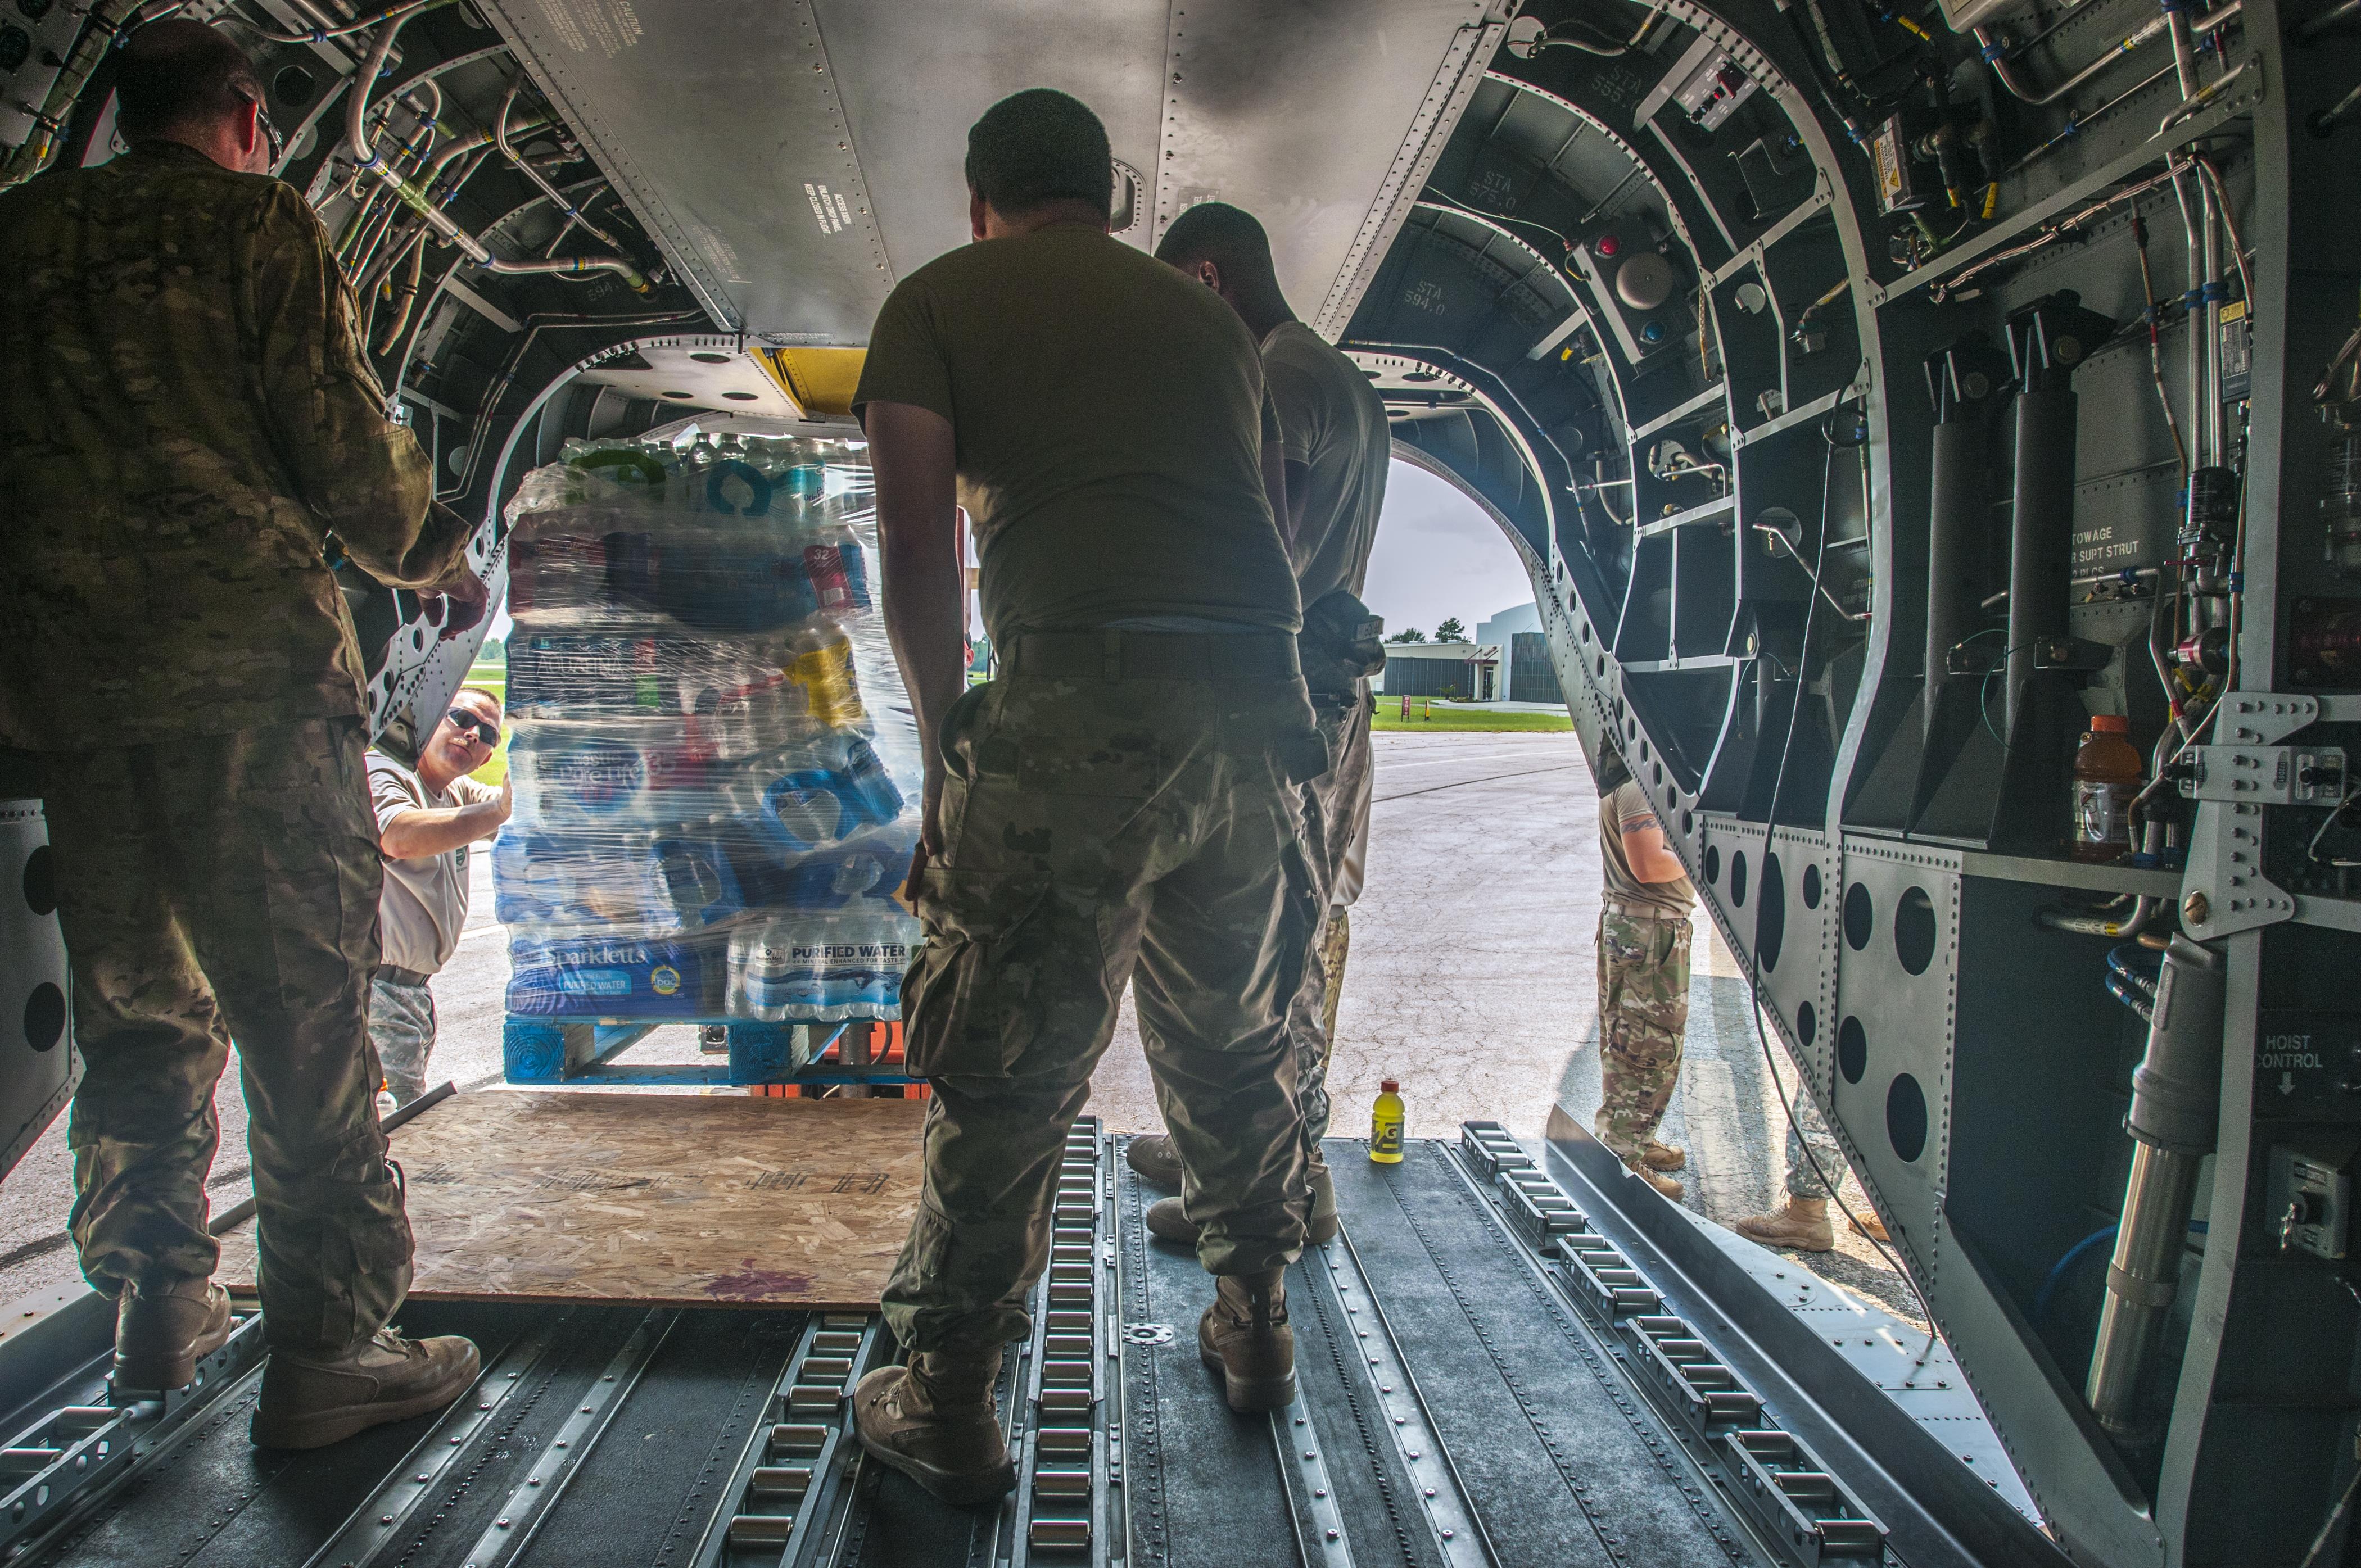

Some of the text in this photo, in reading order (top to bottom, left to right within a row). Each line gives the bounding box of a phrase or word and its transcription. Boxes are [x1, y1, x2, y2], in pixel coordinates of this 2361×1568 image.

[619, 1, 644, 35] CAUTION
[804, 184, 816, 196] KEEP
[1484, 170, 1511, 193] STA
[809, 196, 823, 214] CLOSED
[818, 185, 842, 232] UNLATCH DROP PANEL
[834, 194, 847, 211] ACCESS
[818, 219, 831, 234] FLIGHT
[1417, 280, 1441, 301] STA
[1404, 289, 1445, 316] 594.0
[813, 549, 829, 560] 32
[2079, 547, 2104, 563] SUPT
[2106, 540, 2139, 558] STRUT
[544, 946, 646, 969] Sparkletts
[792, 945, 906, 959] PURIFIED WATER
[598, 980, 626, 990] WATER
[2265, 1035, 2310, 1050] HOIST
[1384, 1125, 1397, 1139] G
